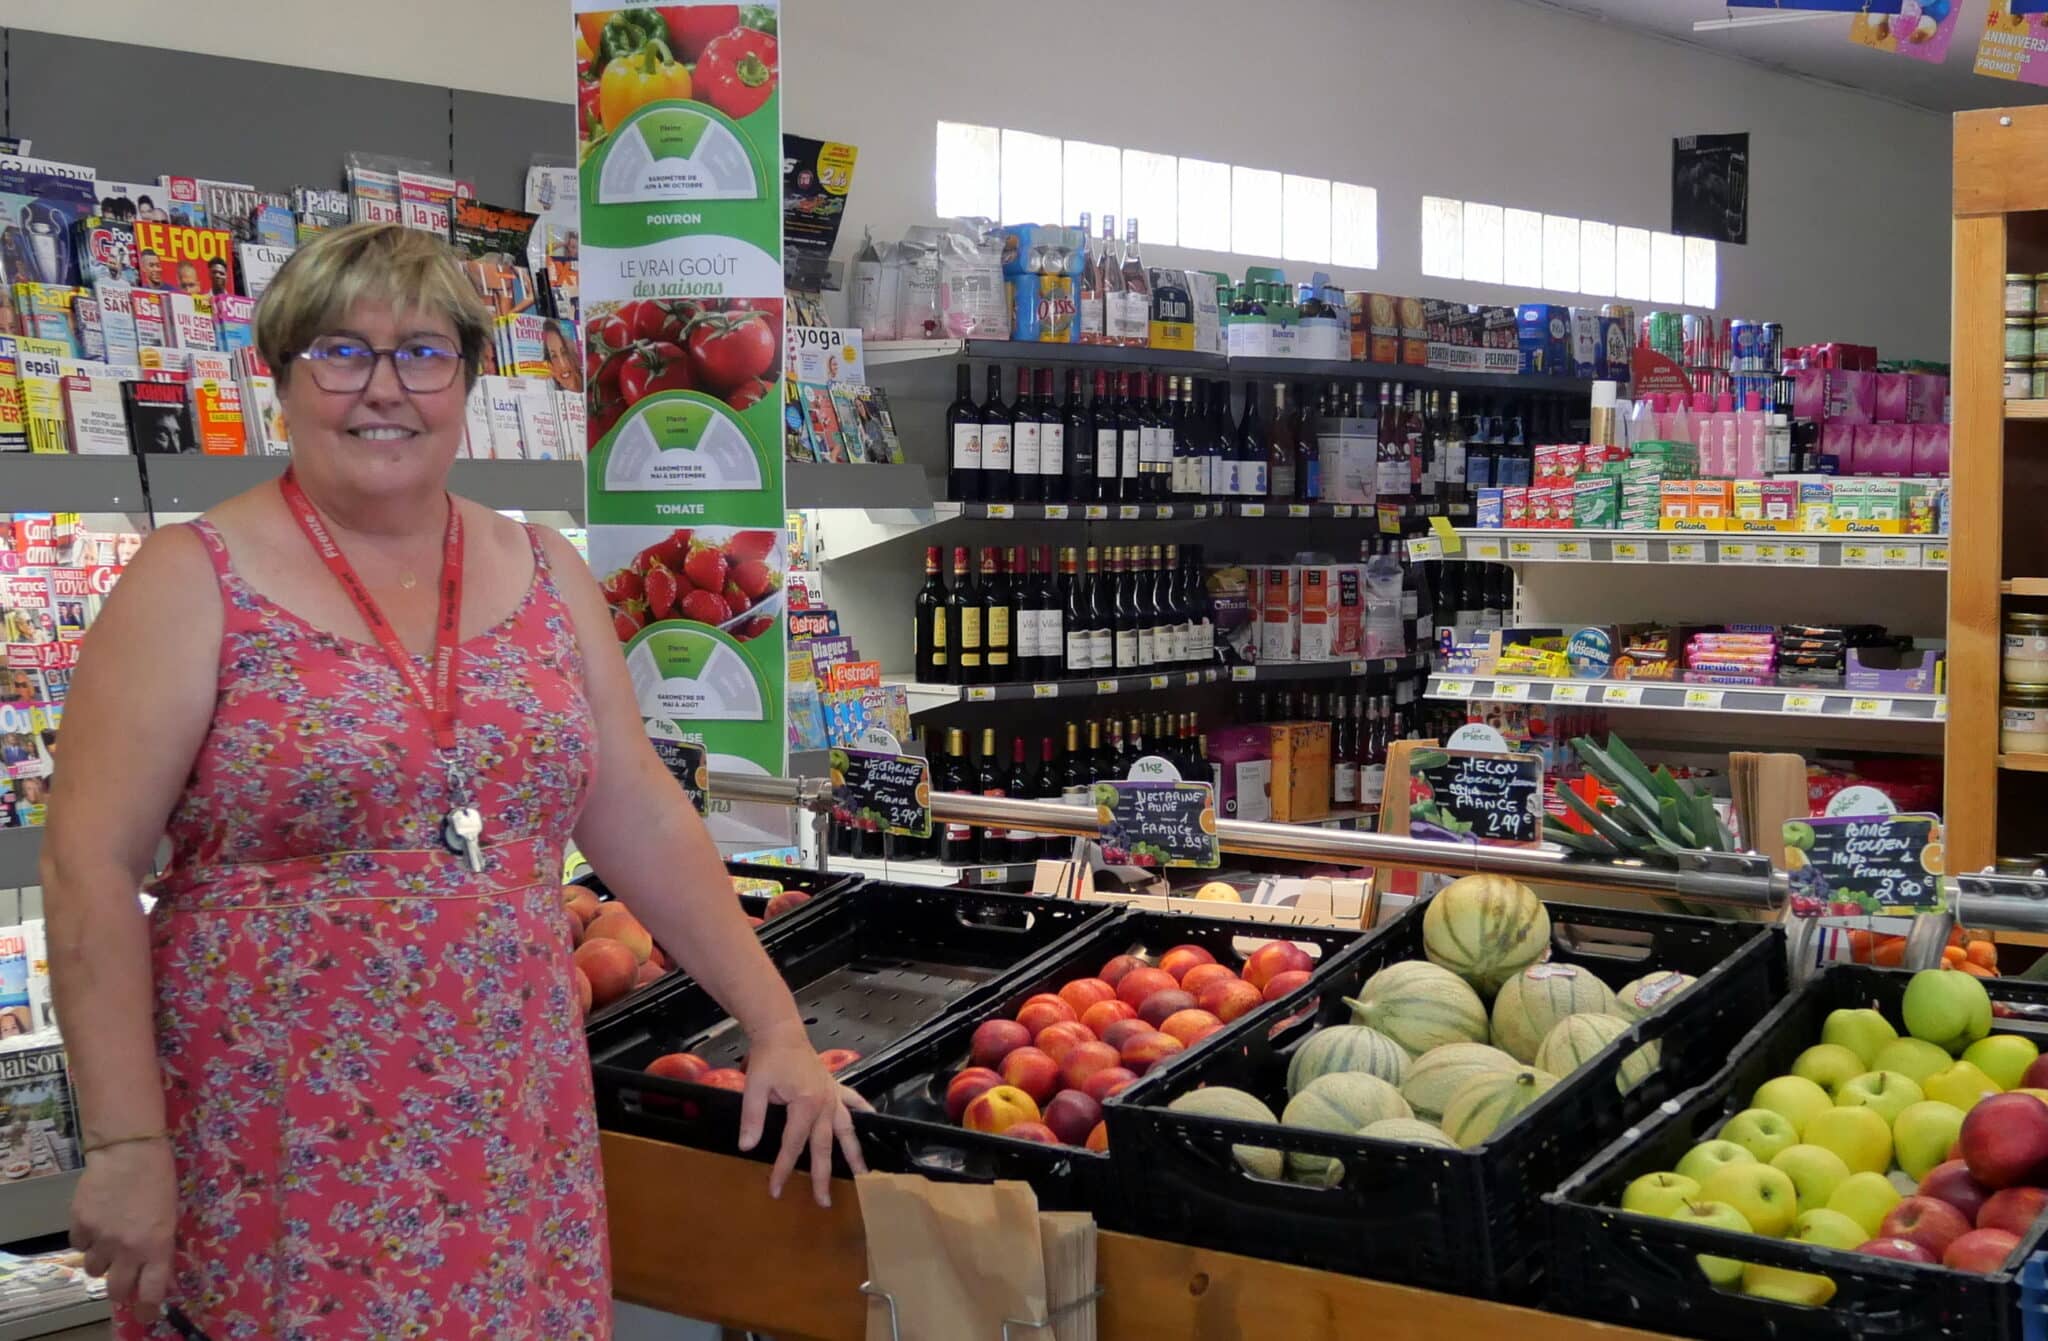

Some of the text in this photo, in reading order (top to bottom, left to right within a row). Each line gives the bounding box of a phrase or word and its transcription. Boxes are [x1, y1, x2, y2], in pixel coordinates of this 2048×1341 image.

[414, 205, 427, 224] la
[647, 215, 701, 225] POIVRON
[136, 222, 230, 262] LE FOOT
[620, 254, 738, 279] LE VRAI GOÛT
[633, 279, 723, 297] des saisons
[797, 329, 841, 350] yoga
[656, 504, 704, 514] TOMATE
[812, 640, 848, 659] Blagues
[1696, 663, 1740, 673] mentos
[868, 734, 888, 746] 1kg
[864, 759, 925, 776] NECTARINE
[1139, 762, 1164, 774] 1kg
[1463, 757, 1518, 776] MELON
[868, 771, 916, 786] BLANCHE
[874, 791, 909, 805] France
[1136, 790, 1203, 804] NECTARINE
[1456, 795, 1518, 812] FRANCE
[1135, 801, 1178, 812] JAUNE
[1141, 823, 1193, 835] FRANCE
[1854, 865, 1907, 879] France
